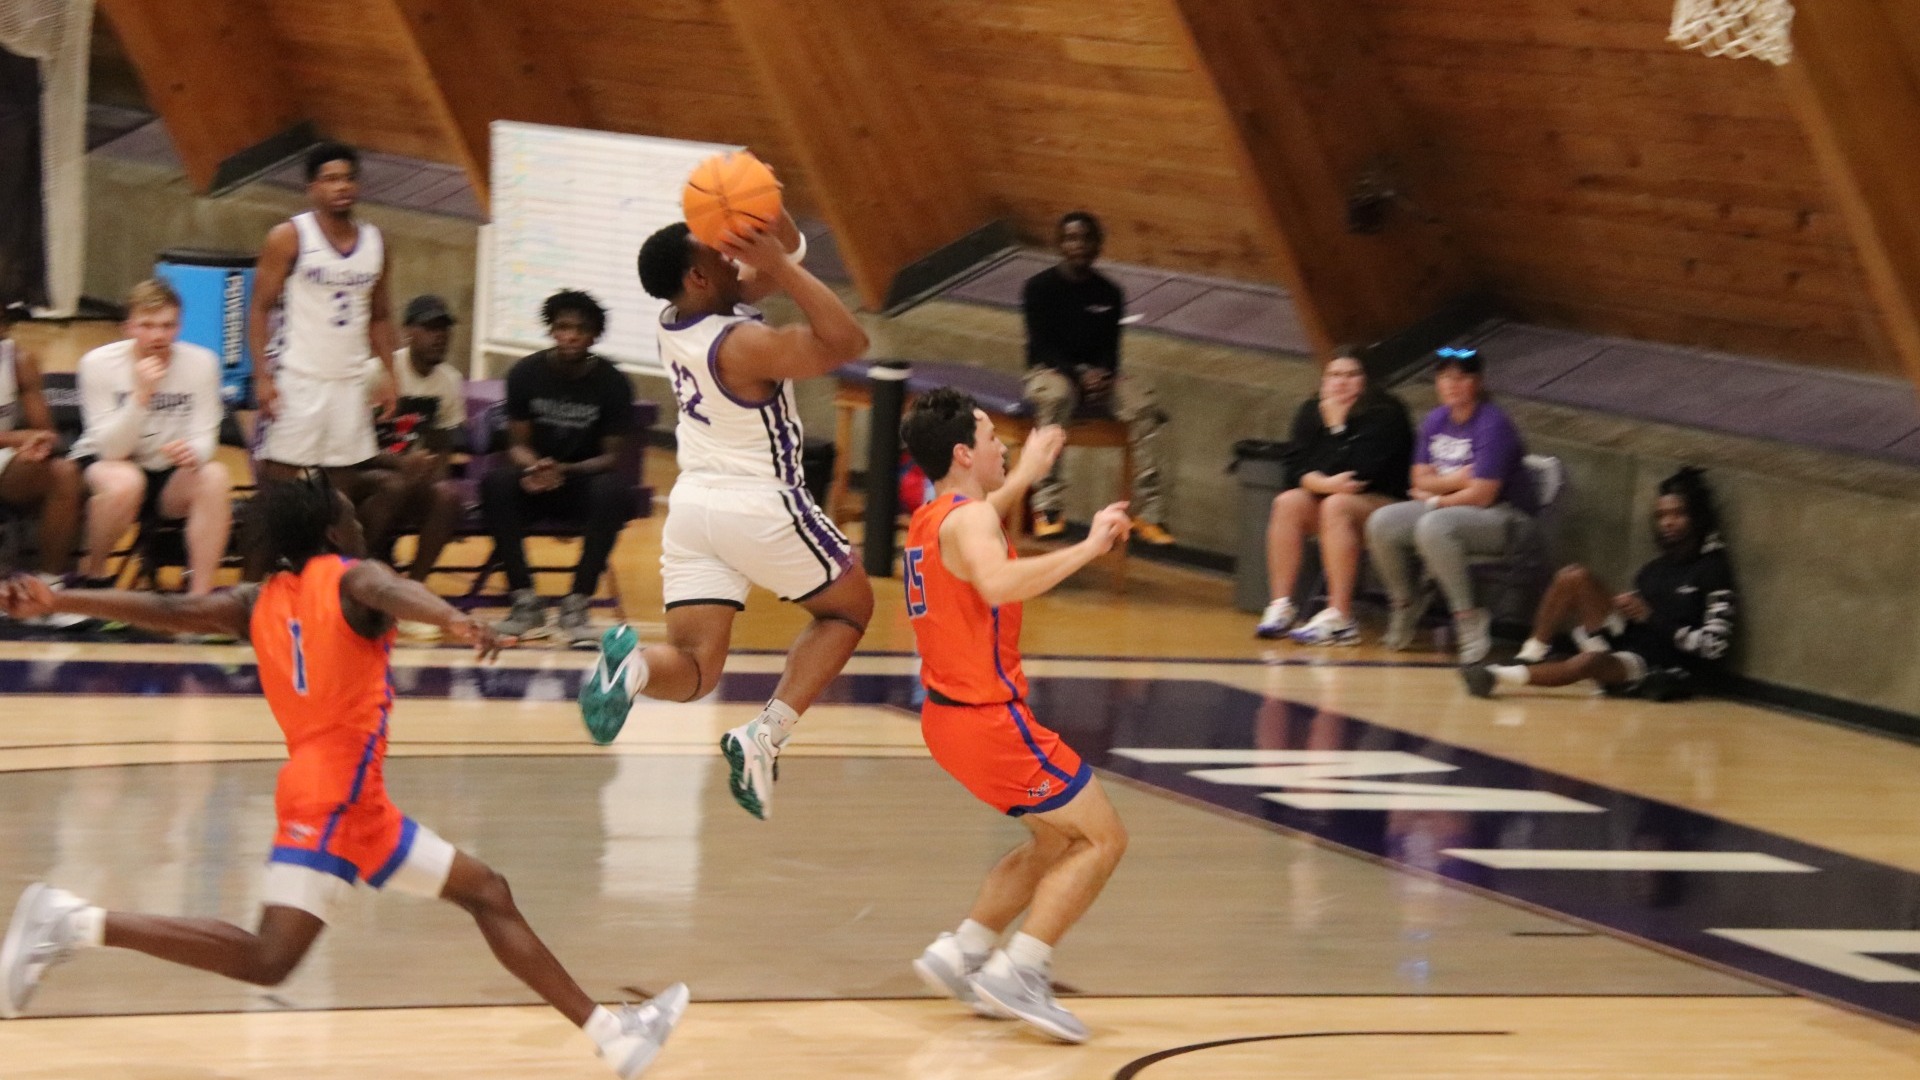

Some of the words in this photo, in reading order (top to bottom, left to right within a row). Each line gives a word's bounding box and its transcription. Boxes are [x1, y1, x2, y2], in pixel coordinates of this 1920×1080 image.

[223, 275, 244, 364] POWERADE
[903, 546, 928, 619] 15
[287, 618, 309, 696] 1
